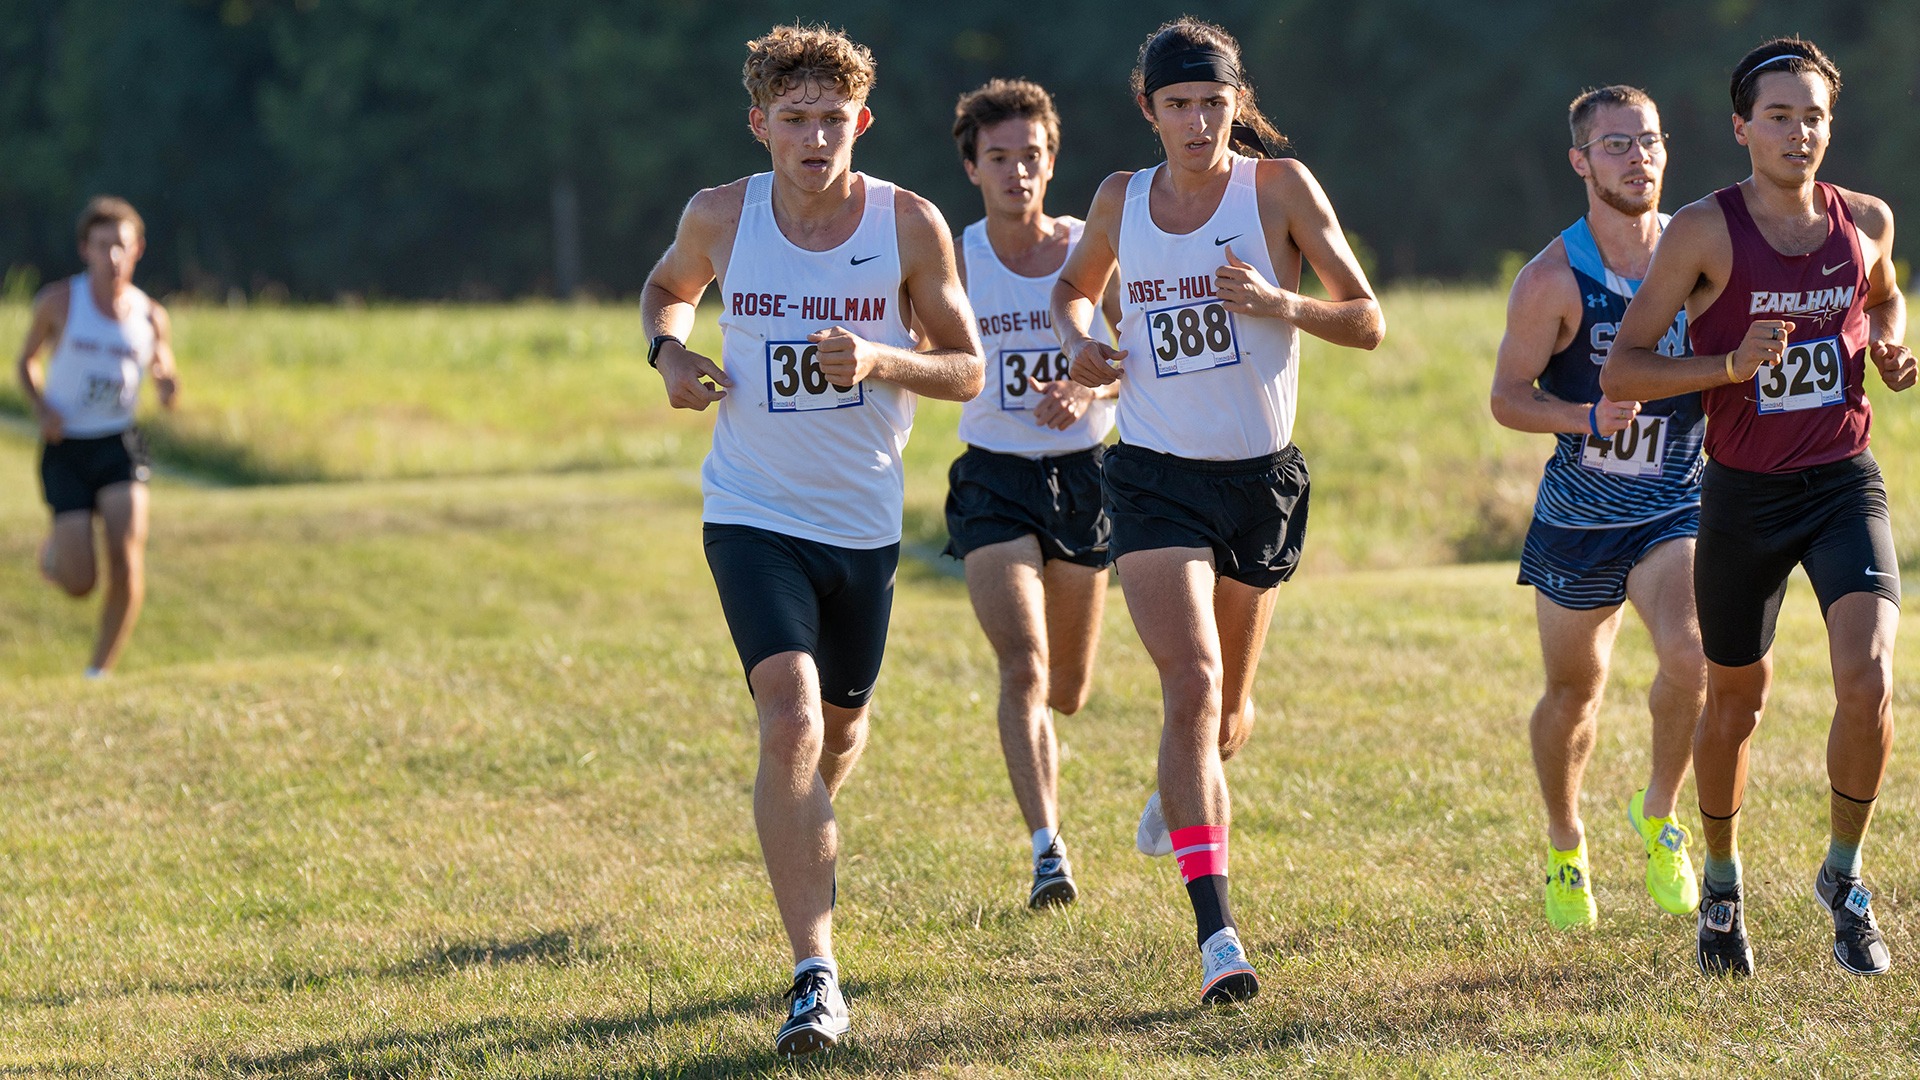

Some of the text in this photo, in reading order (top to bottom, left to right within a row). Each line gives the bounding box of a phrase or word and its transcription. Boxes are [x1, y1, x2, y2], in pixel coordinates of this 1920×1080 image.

[732, 292, 886, 321] ROSE-HULMAN
[1127, 275, 1217, 304] ROSE-HUL
[1749, 285, 1855, 315] EARLHAM
[979, 310, 1052, 336] ROSE-HU
[1153, 303, 1232, 362] 388
[772, 345, 854, 397] 36
[1005, 352, 1072, 397] 348
[1760, 342, 1839, 398] 329
